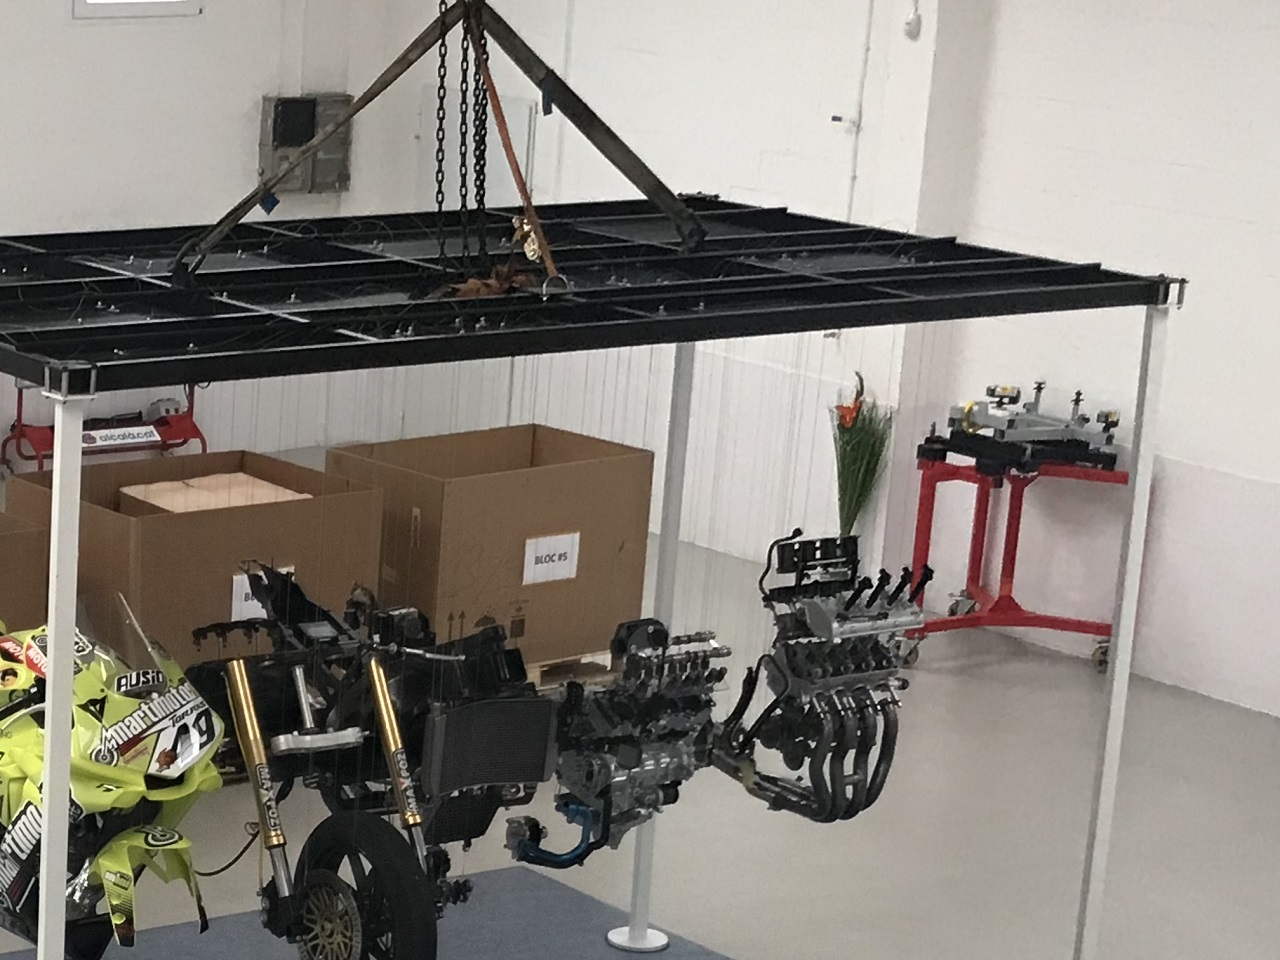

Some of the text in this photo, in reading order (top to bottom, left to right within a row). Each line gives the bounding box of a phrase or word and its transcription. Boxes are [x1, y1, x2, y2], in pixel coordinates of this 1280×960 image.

[534, 551, 568, 565] BLOC #5
[26, 646, 47, 674] MOTU
